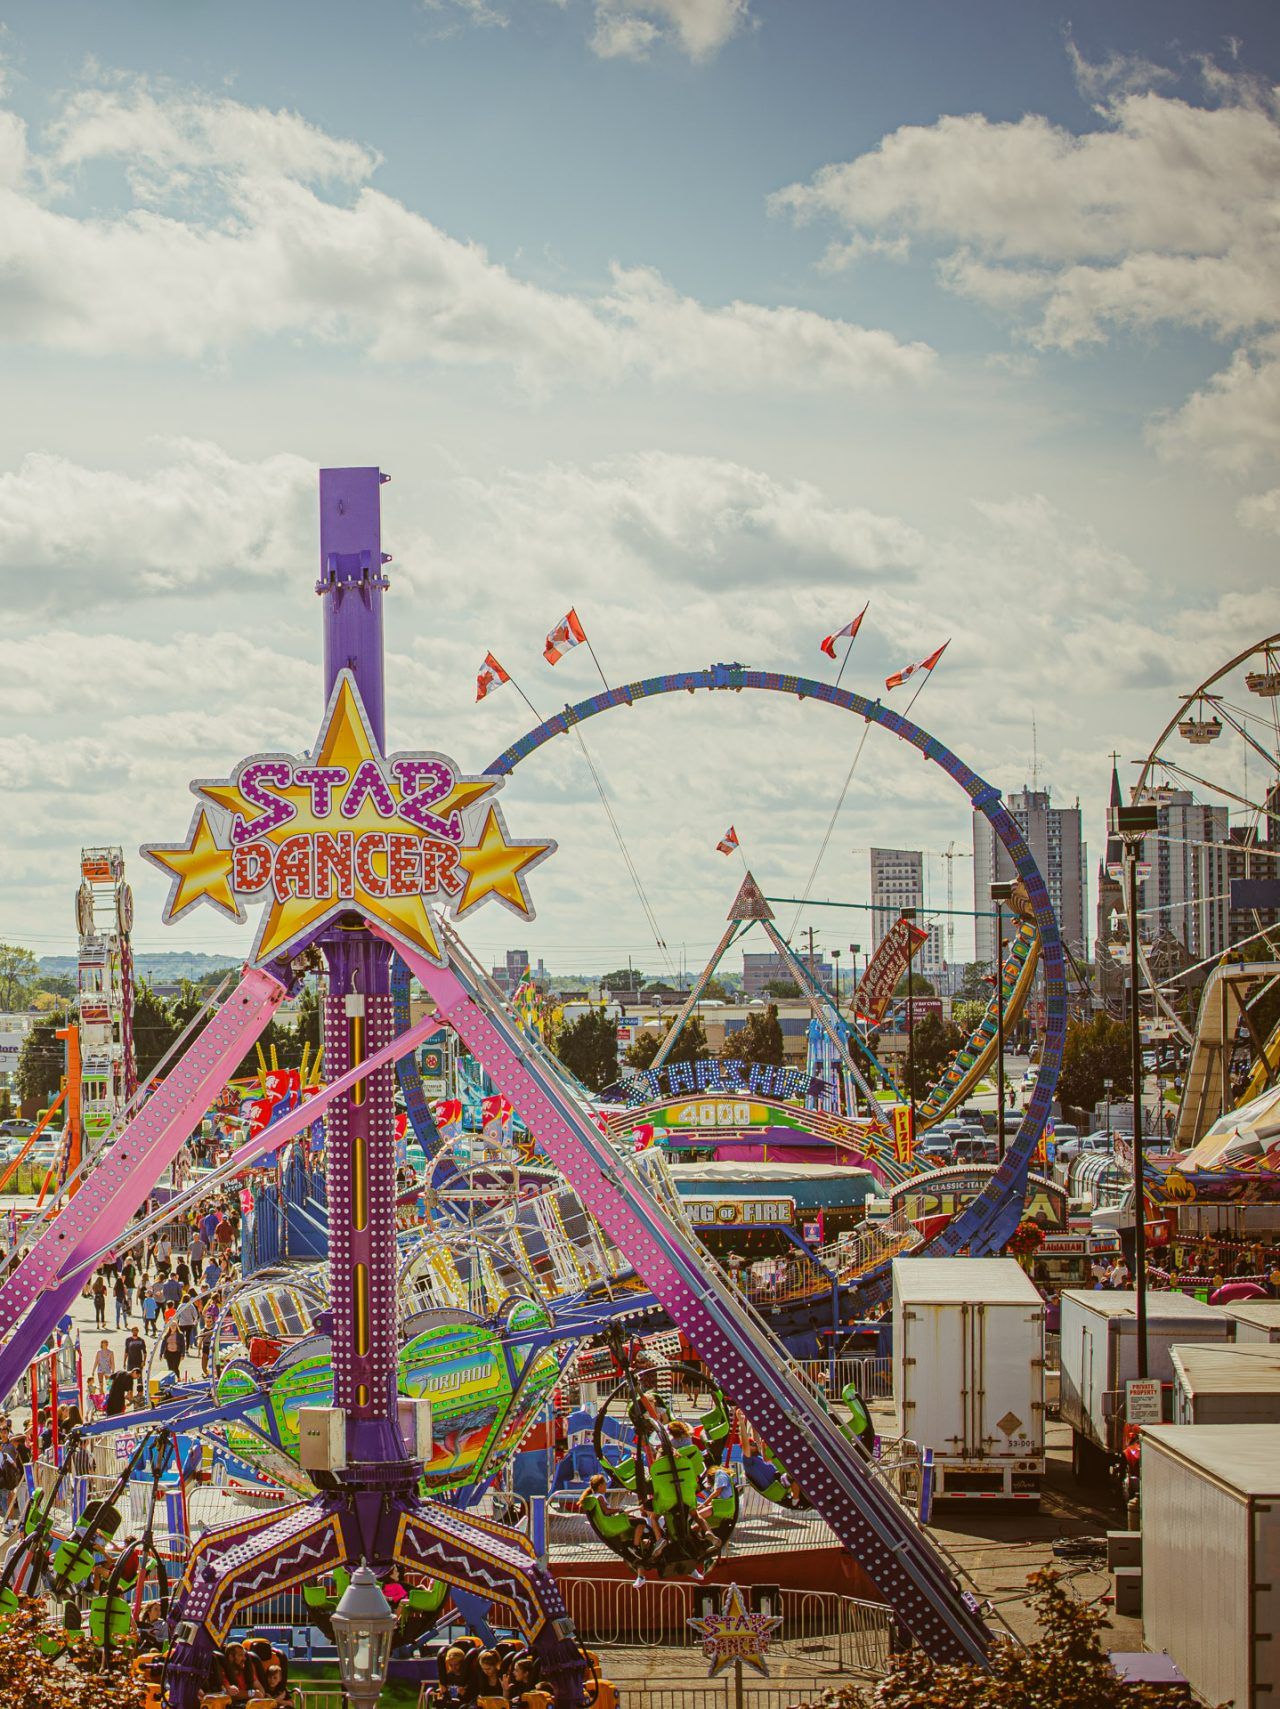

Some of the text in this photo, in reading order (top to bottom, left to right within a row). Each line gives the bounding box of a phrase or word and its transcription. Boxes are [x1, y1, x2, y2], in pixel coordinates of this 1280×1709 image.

[230, 759, 464, 844] STAR
[232, 831, 465, 903] DANCER
[678, 1102, 750, 1126] 4000
[930, 1182, 965, 1192] CLASSIC
[720, 1207, 734, 1219] OF
[743, 1203, 790, 1221] FIRE
[411, 1363, 492, 1399] TORNADO
[703, 1615, 771, 1639] STAR
[703, 1636, 770, 1655] DANCER
